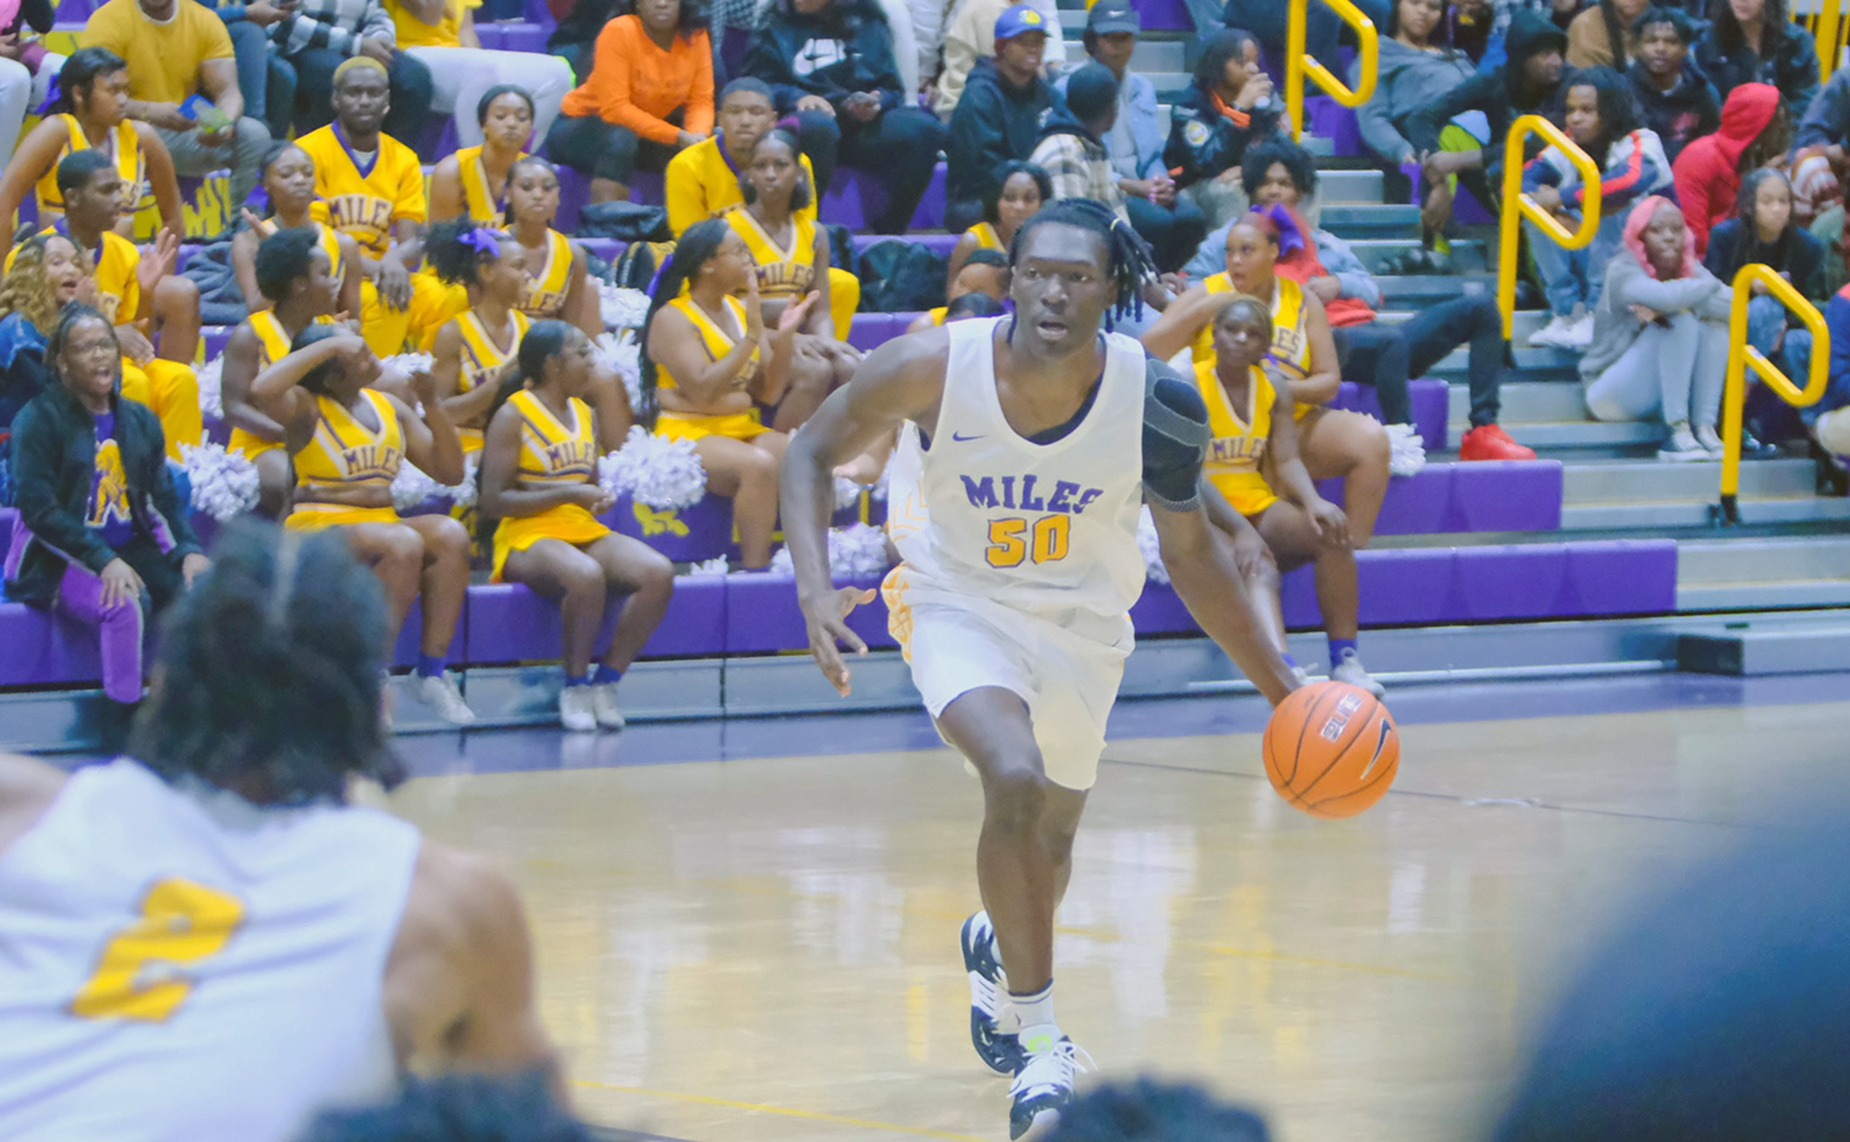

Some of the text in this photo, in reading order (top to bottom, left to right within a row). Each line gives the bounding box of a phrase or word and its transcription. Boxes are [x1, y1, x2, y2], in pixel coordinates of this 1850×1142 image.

[328, 196, 390, 232] MILE
[545, 441, 595, 471] MILE
[1211, 437, 1265, 460] MILE
[960, 474, 1104, 514] MILES
[985, 514, 1070, 569] 50
[70, 874, 248, 1026] 2
